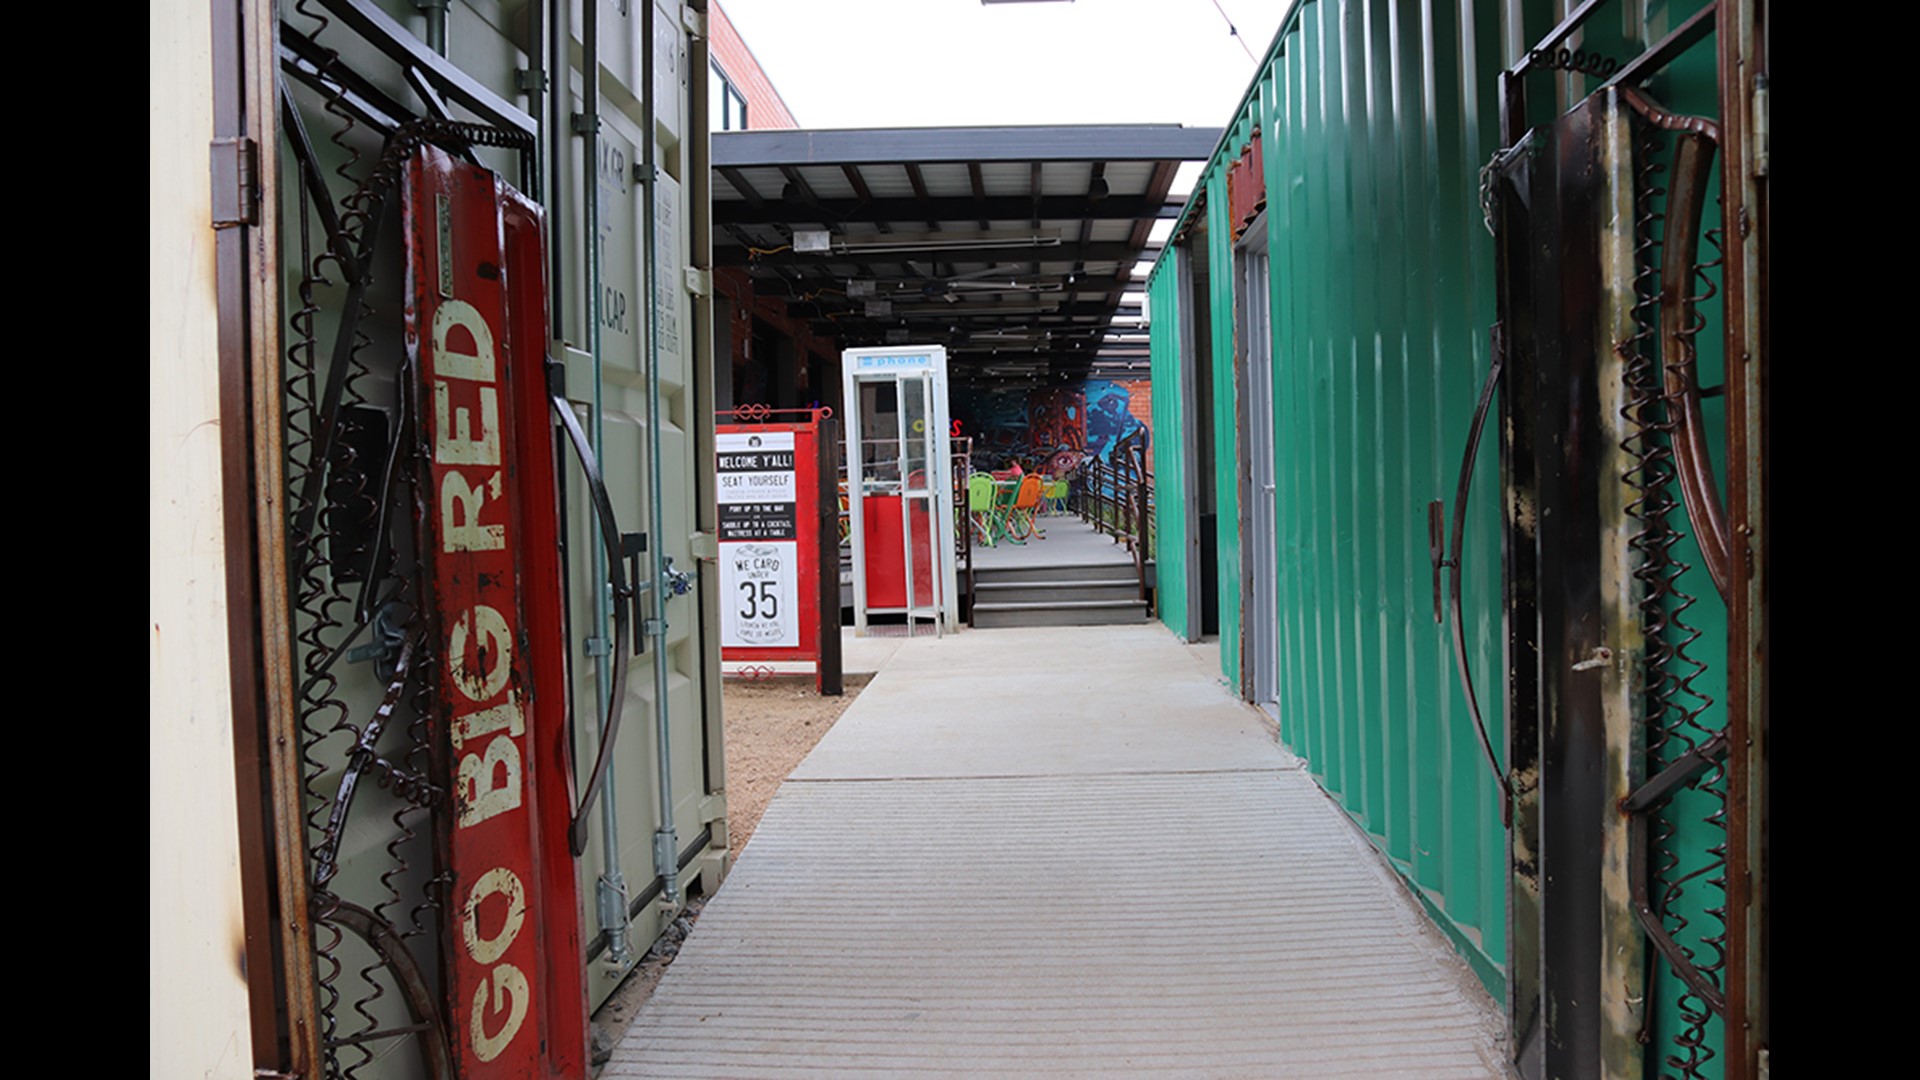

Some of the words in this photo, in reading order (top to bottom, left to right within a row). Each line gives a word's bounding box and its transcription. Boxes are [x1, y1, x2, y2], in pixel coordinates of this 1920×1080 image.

[877, 356, 926, 367] phone
[432, 300, 505, 553] RED
[719, 455, 758, 469] WELCOME
[763, 454, 792, 468] Y'ALL!
[722, 475, 743, 488] SEAT
[748, 474, 789, 487] YOURSELF
[735, 560, 750, 571] WE
[753, 558, 780, 572] CARD
[747, 570, 769, 579] UNDER
[739, 581, 777, 619] 35
[449, 605, 526, 829] BIG
[463, 867, 530, 1063] GO
